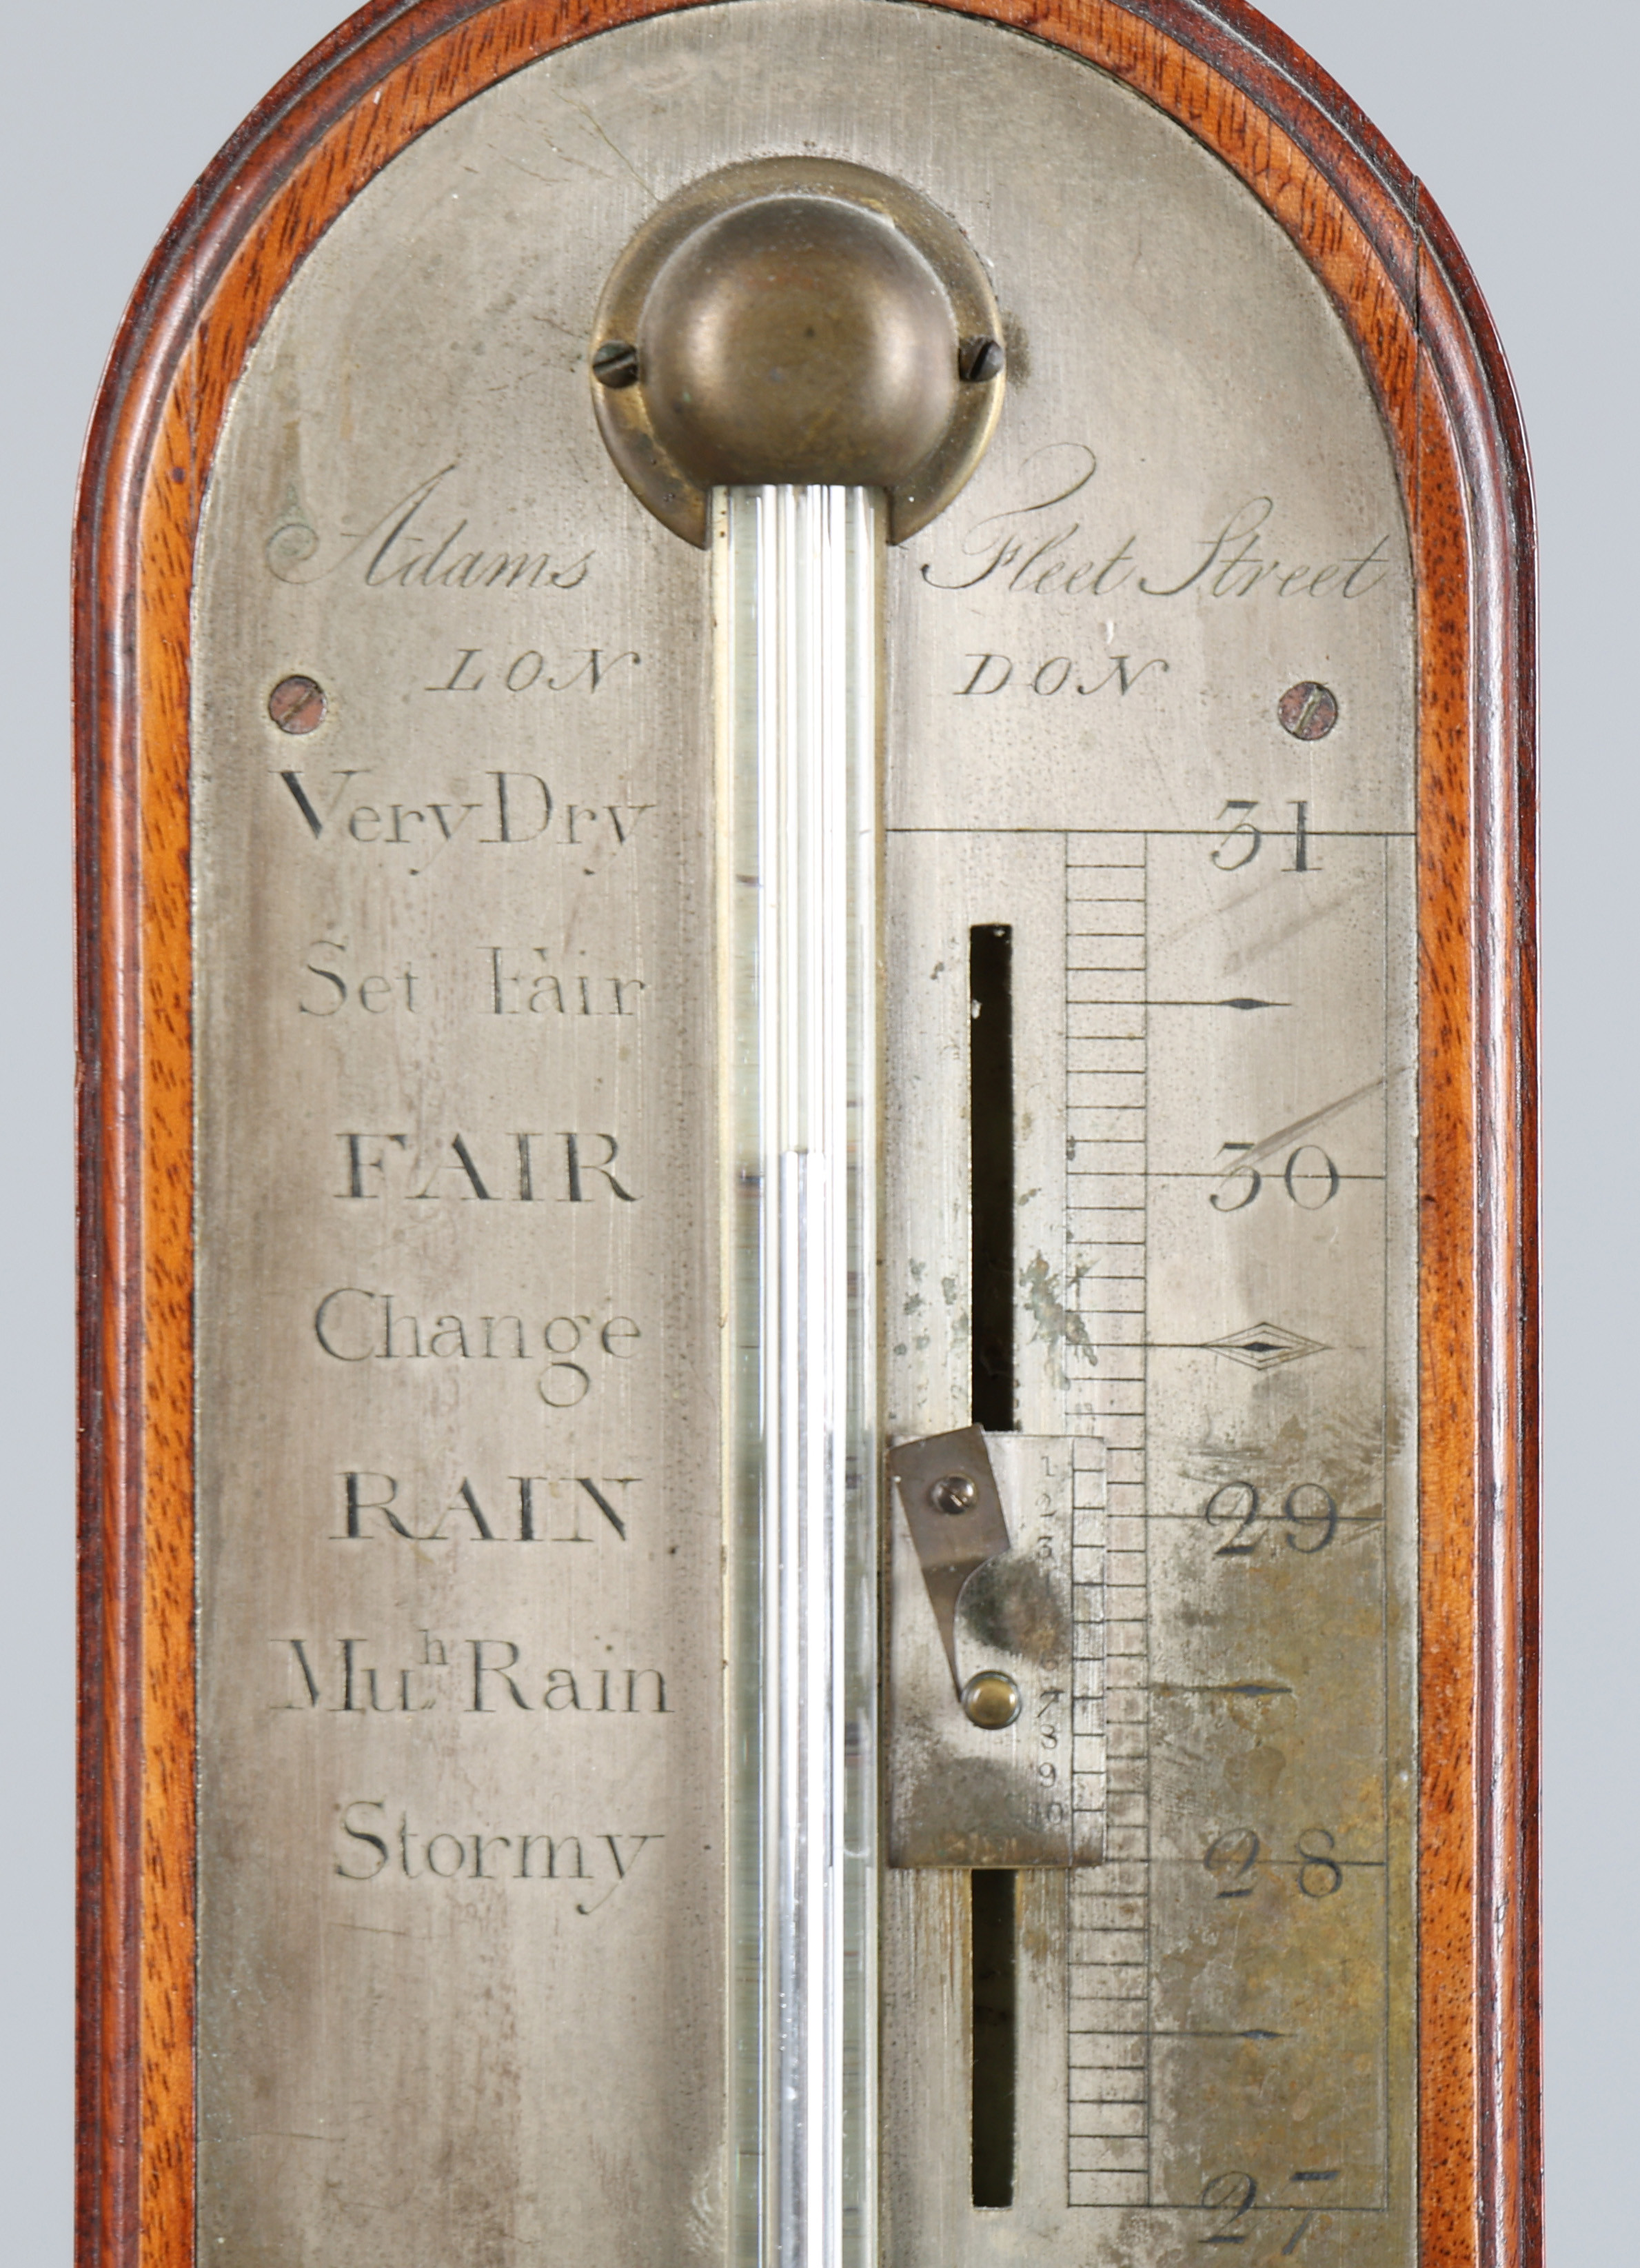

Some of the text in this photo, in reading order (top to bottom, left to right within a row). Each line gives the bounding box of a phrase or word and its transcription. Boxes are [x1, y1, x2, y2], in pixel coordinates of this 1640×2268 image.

[266, 442, 1390, 599] Adams Fleet Street
[424, 648, 1170, 696] LON DON
[268, 769, 657, 876] Very Dry
[1211, 800, 1324, 873] 31
[299, 940, 647, 1016] Set Fair
[333, 1132, 644, 1203] FAIR
[1210, 1141, 1340, 1212] 30
[314, 1287, 643, 1408] Change
[328, 1470, 643, 1542] RAIN
[1205, 1481, 1337, 1554] 29
[463, 1638, 676, 1713] Rain
[336, 1800, 665, 1916] Stormy
[1203, 1827, 1343, 1898] 28
[1198, 2171, 1342, 2256] 27
